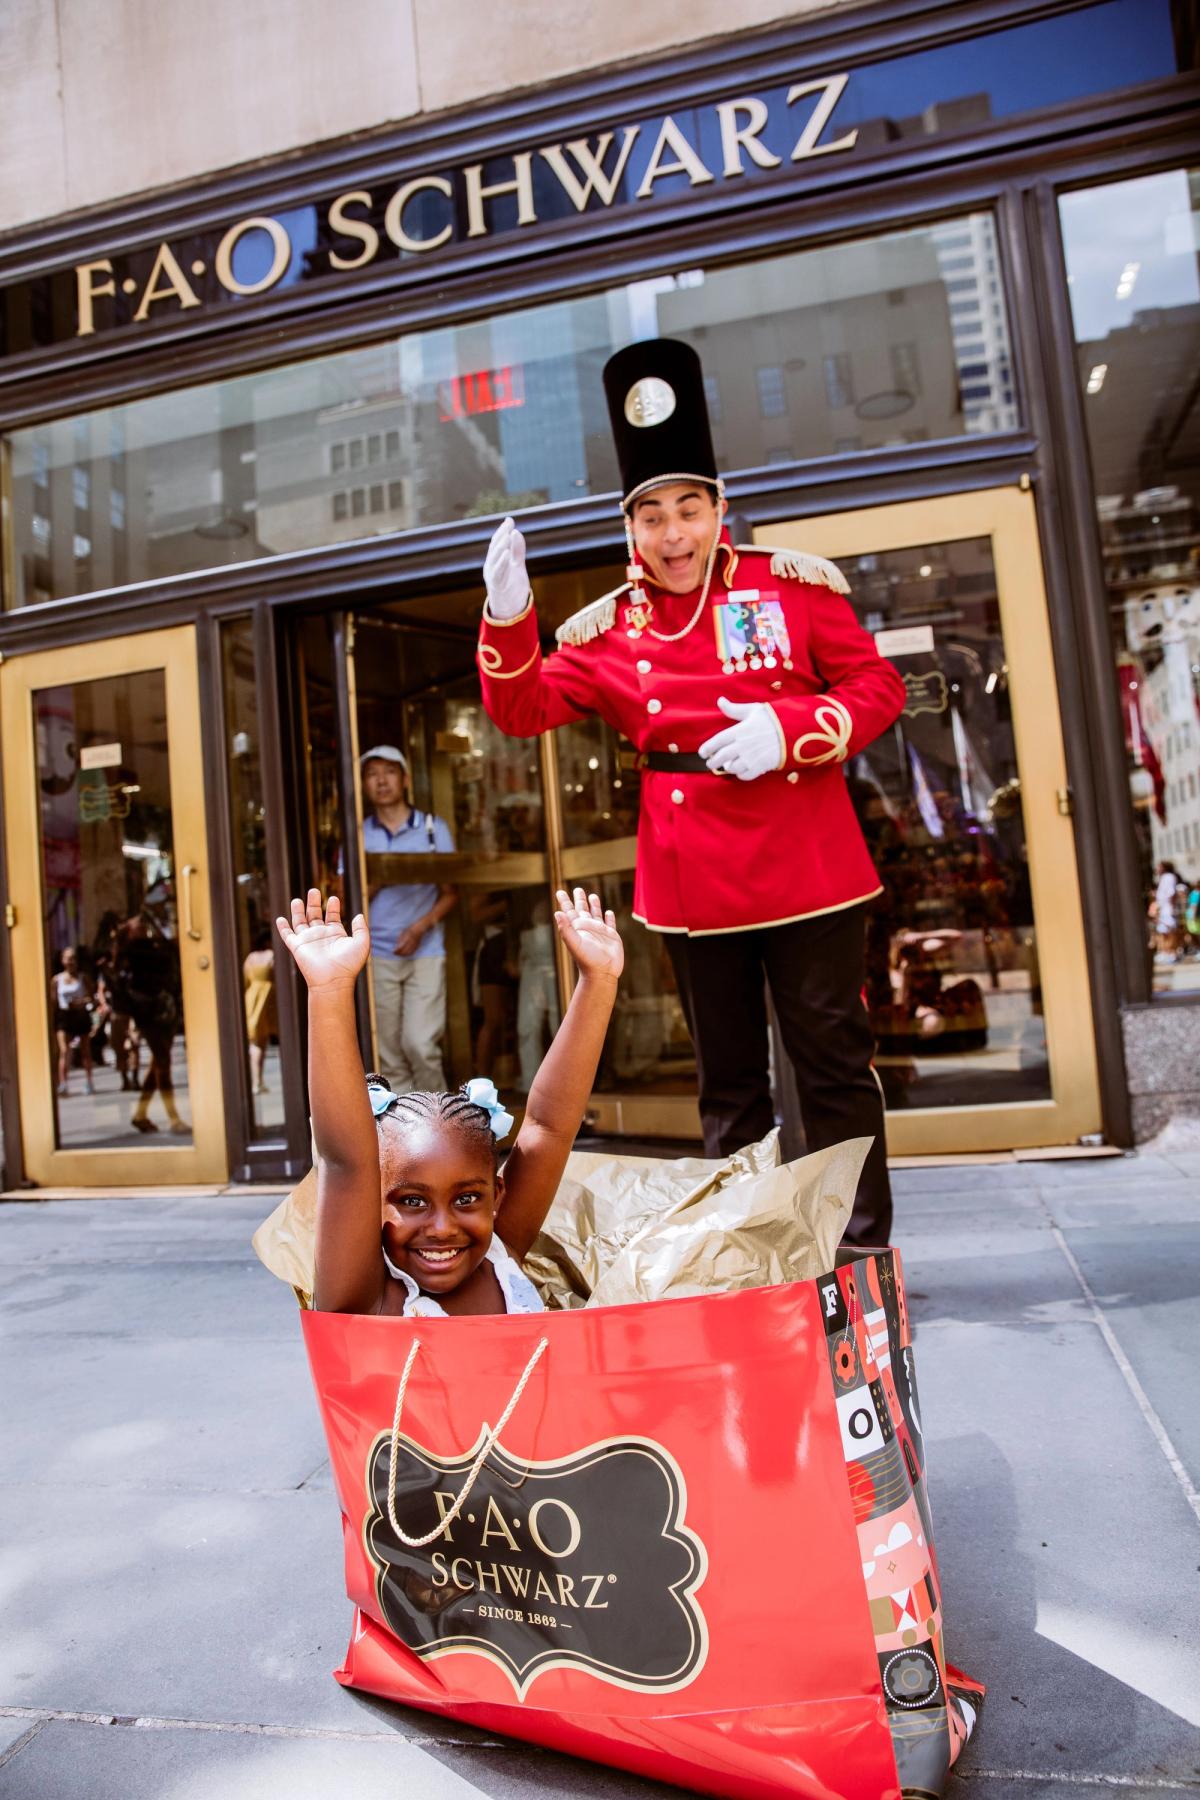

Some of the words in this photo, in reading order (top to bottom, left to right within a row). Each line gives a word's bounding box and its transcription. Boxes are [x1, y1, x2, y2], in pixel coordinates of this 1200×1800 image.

[328, 73, 859, 270] SCHWARZ
[821, 1283, 838, 1318] F
[848, 1408, 873, 1439] O
[478, 1605, 524, 1622] SINCE
[527, 1612, 557, 1628] 1862
